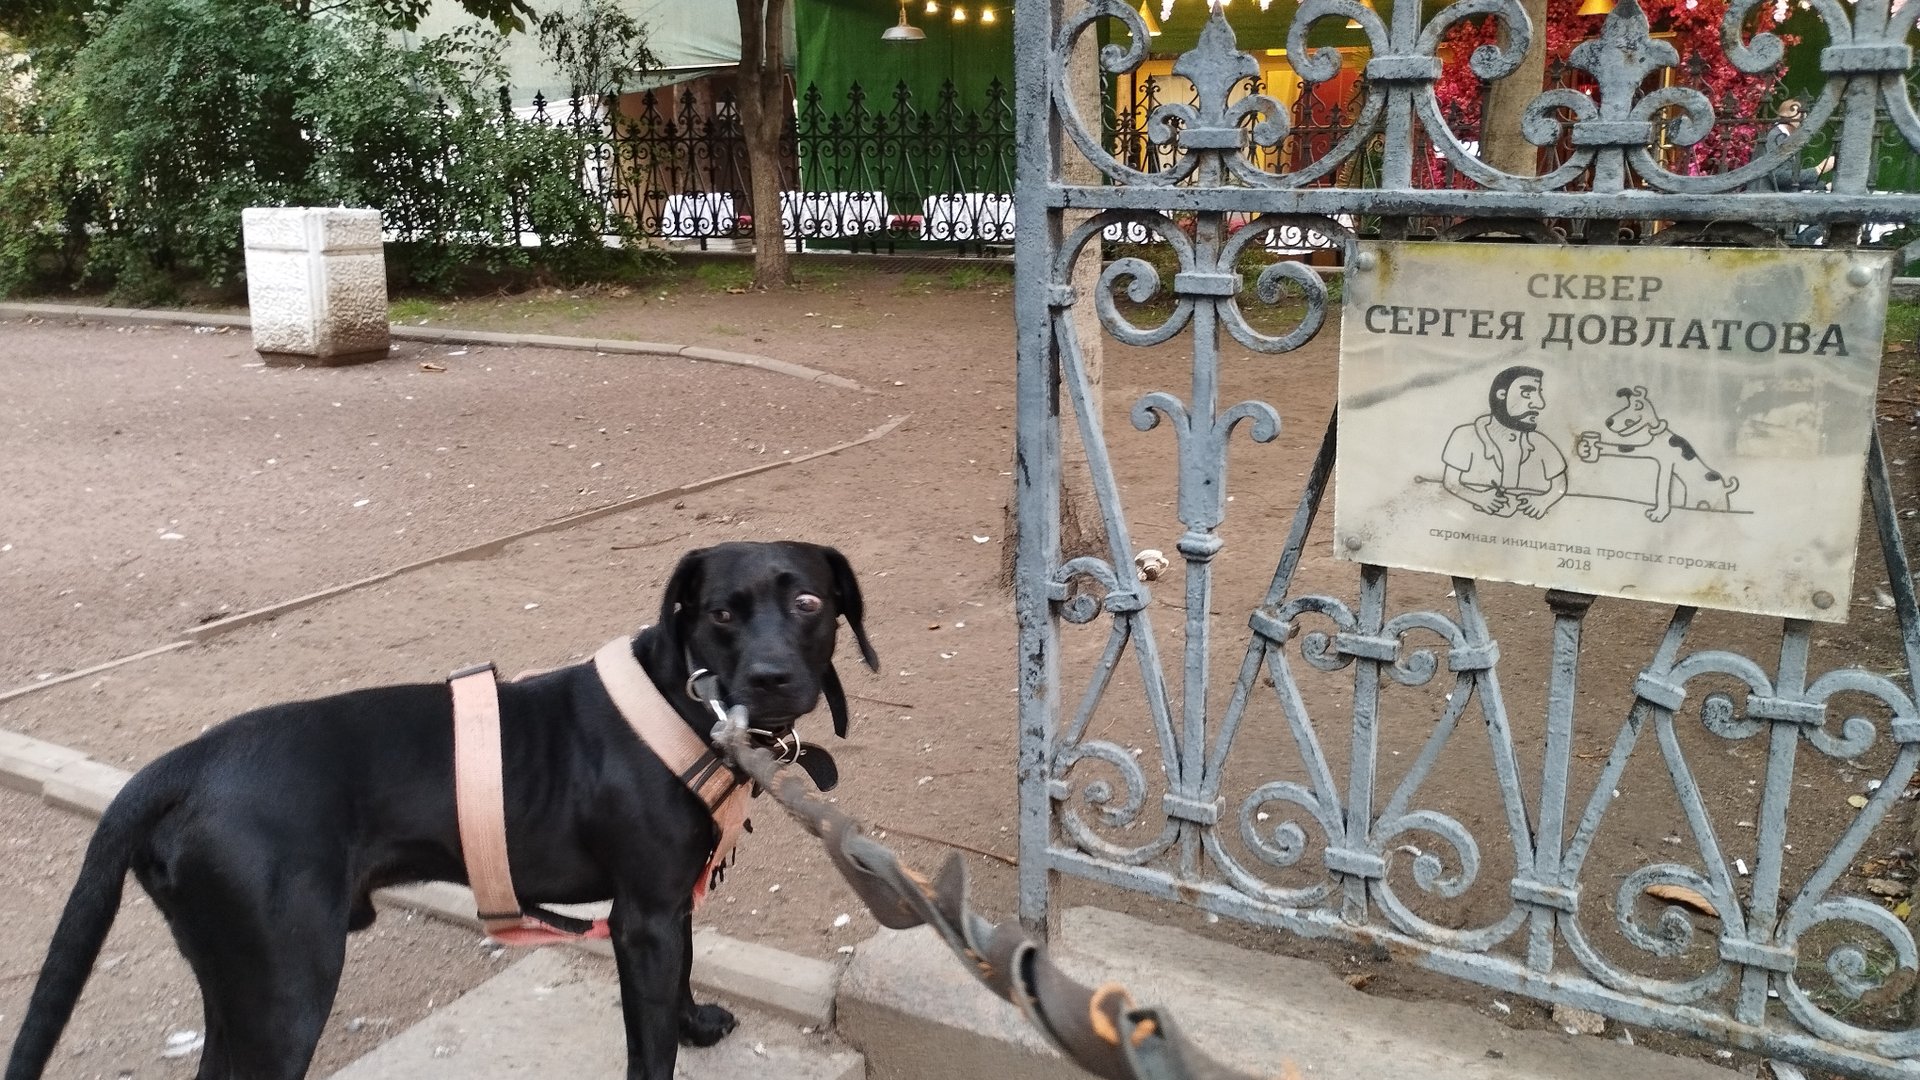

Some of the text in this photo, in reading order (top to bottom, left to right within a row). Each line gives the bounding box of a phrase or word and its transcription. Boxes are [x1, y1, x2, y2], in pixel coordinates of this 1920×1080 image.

[1527, 273, 1663, 302] СКВЕР
[1364, 304, 1850, 356] СЕРГЕЯ ДОВЛАТОВА
[1429, 527, 1737, 572] скромная инициатива простых горожан
[1557, 556, 1592, 572] 2018
